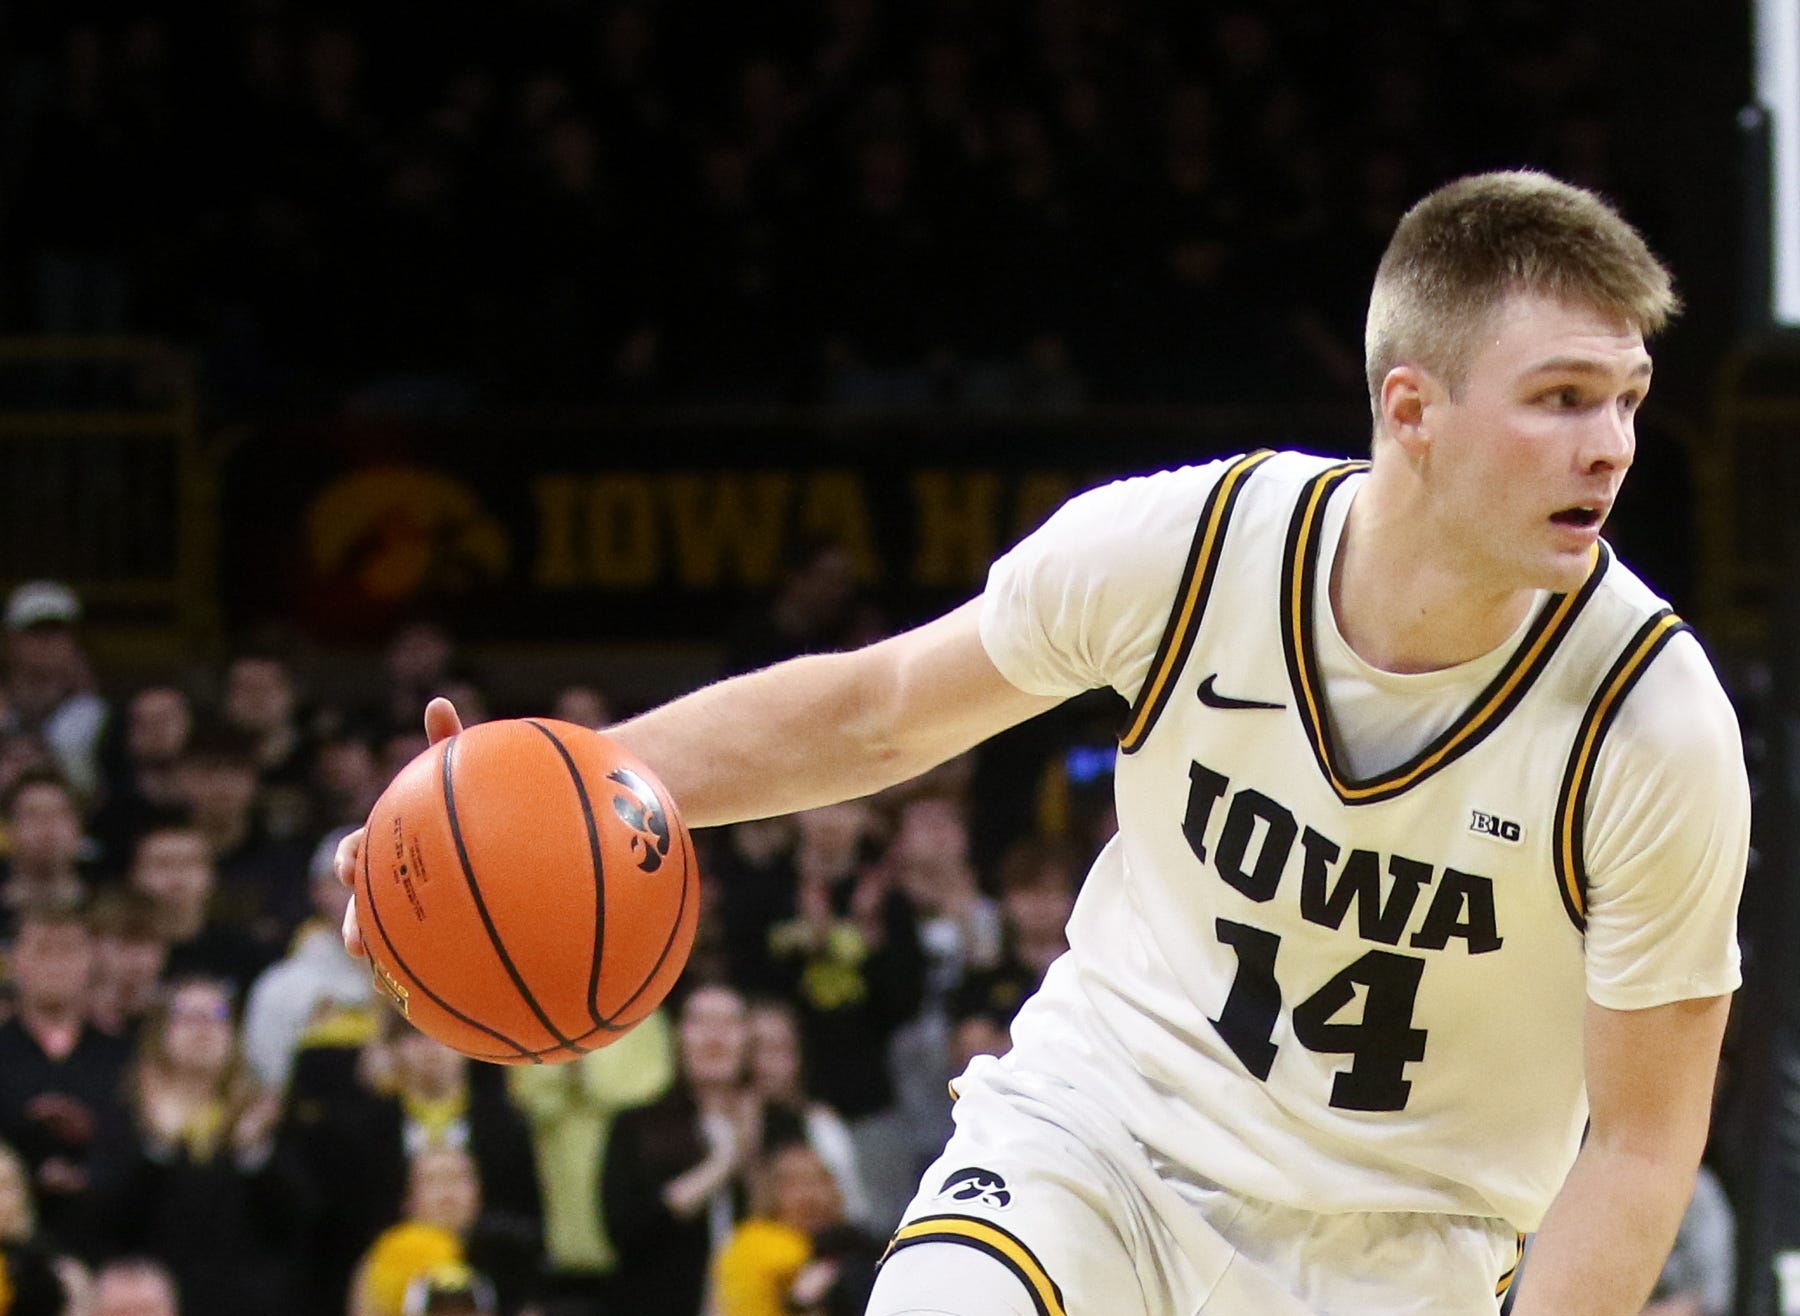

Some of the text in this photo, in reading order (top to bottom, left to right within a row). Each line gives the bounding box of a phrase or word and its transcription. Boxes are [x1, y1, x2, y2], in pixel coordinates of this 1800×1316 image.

[531, 470, 880, 588] IOWA
[1181, 759, 1504, 955] IOWA
[1207, 917, 1428, 1112] 14
